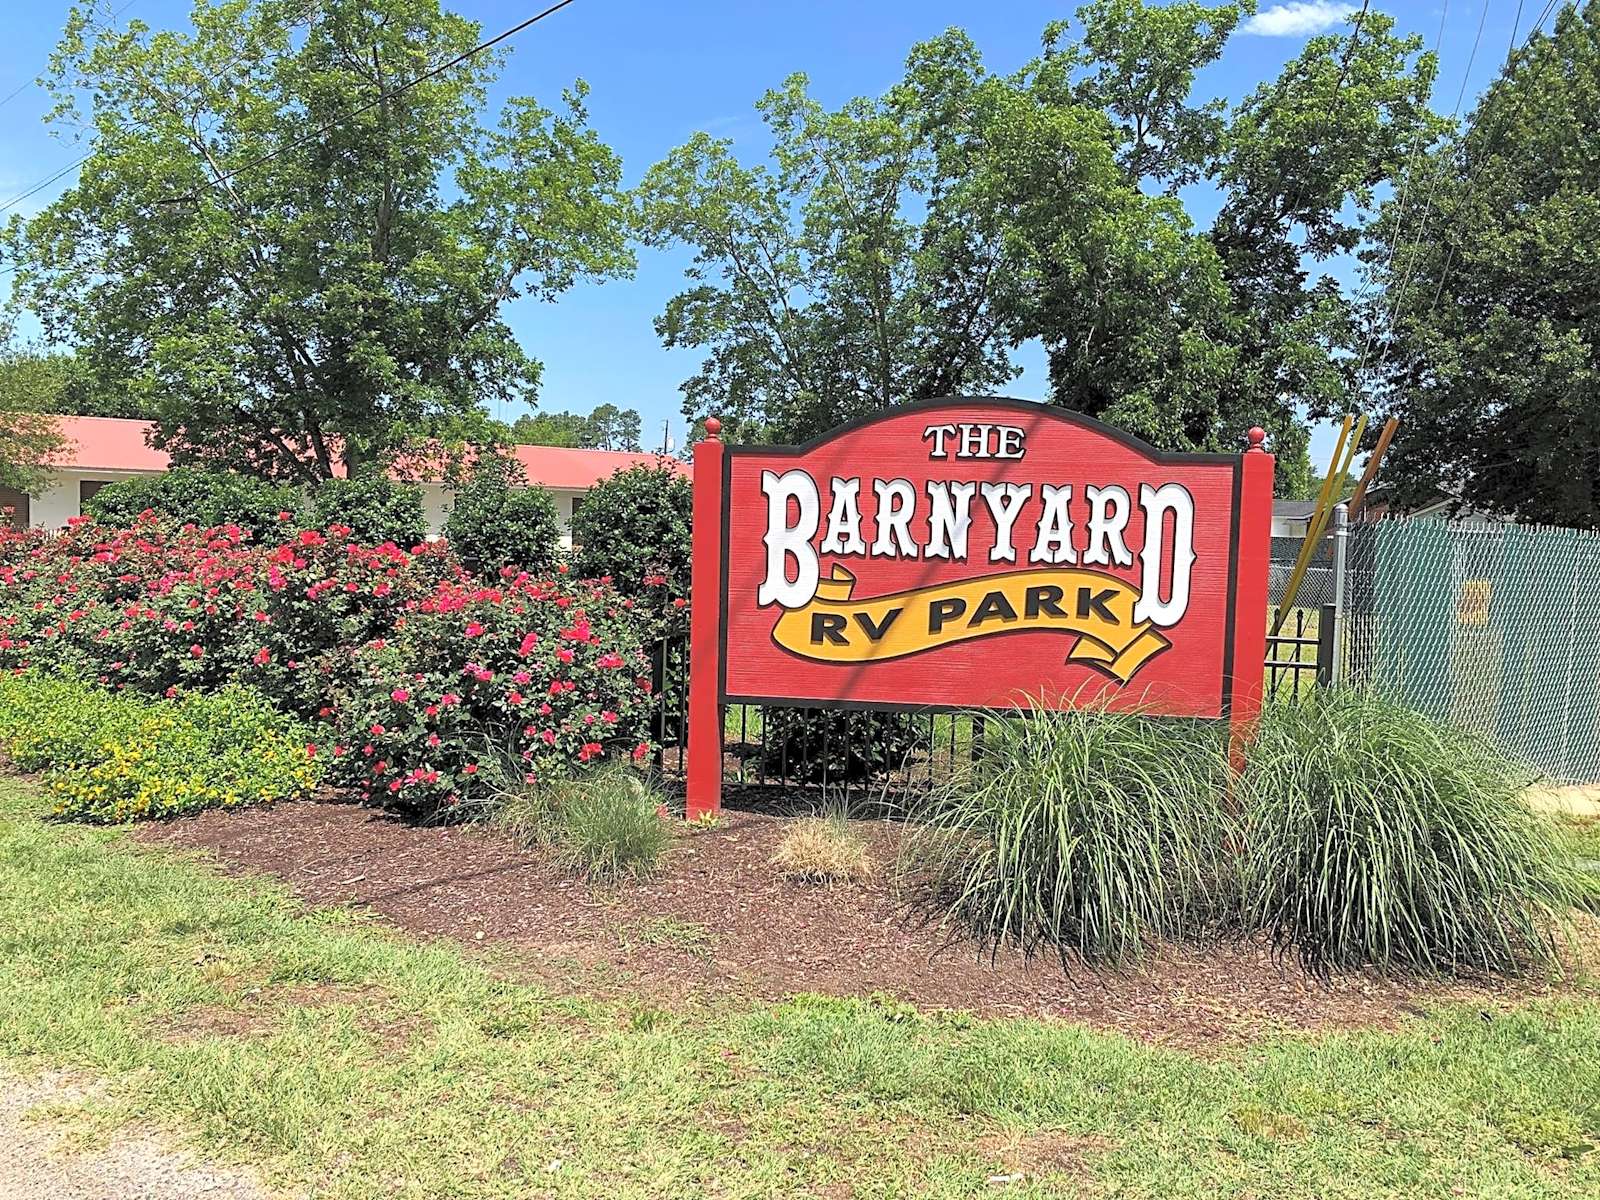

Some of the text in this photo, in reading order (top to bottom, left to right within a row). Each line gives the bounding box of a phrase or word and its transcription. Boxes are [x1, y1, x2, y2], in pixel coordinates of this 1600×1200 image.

[923, 424, 1026, 460] THE
[757, 468, 1197, 628] BARNYARD
[809, 584, 1122, 647] RV PARK
